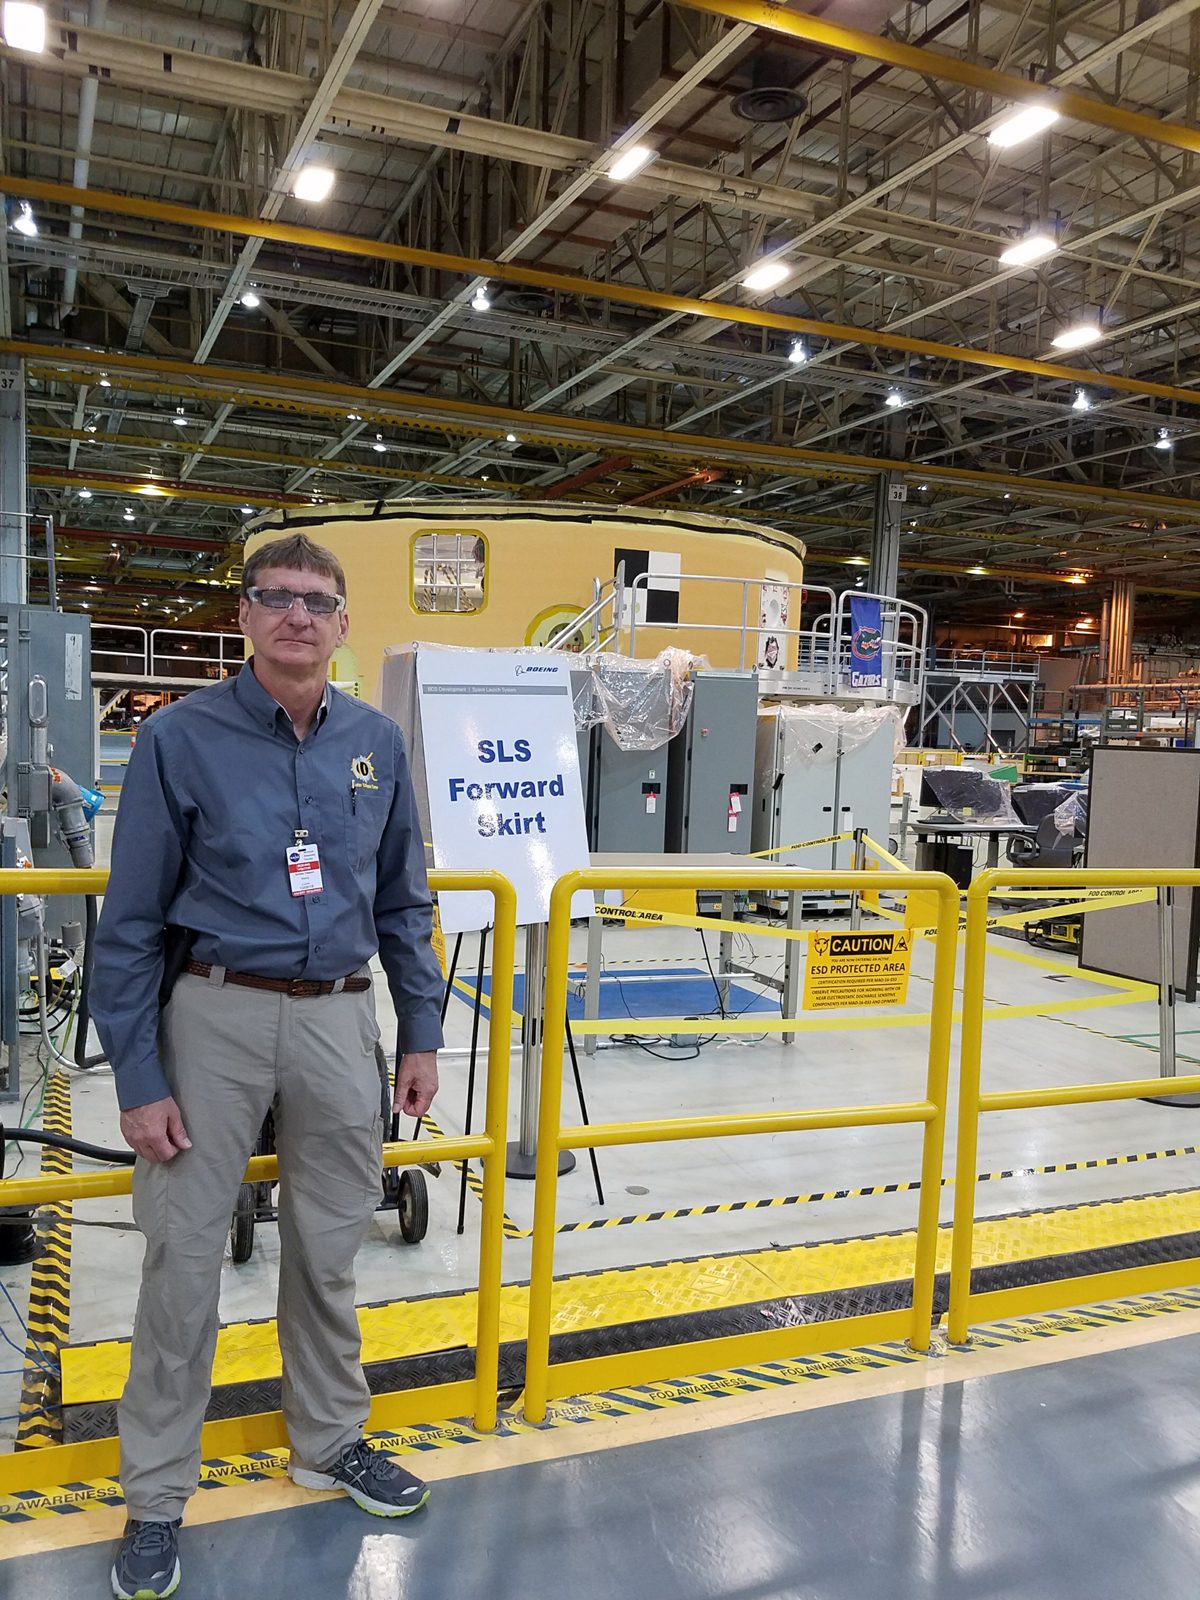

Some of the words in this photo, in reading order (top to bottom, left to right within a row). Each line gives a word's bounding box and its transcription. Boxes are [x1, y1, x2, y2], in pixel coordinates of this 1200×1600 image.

[1, 379, 14, 389] 37
[893, 491, 903, 500] 38
[477, 739, 532, 764] SLS
[449, 775, 565, 801] Forward
[477, 811, 547, 838] Skirt
[802, 839, 826, 848] CONTROL
[827, 835, 842, 843] AREA
[594, 906, 637, 919] CONTROL
[639, 912, 664, 922] AREA
[832, 938, 892, 953] CAUTION
[811, 965, 828, 975] ESD
[830, 963, 881, 974] PROTECTED
[882, 963, 906, 972] AREA
[1112, 1308, 1134, 1316] FOD
[1011, 1326, 1033, 1335] FOD
[1033, 1316, 1089, 1332] AWARENESS
[780, 1366, 805, 1377] FOD
[805, 1355, 872, 1373] AWARENESS
[649, 1390, 675, 1401] FOD
[677, 1377, 748, 1396] AWARENESS
[379, 1427, 464, 1449] AWARENESS
[207, 1456, 289, 1479] AWARENES
[15, 1486, 118, 1512] AWARENESS
